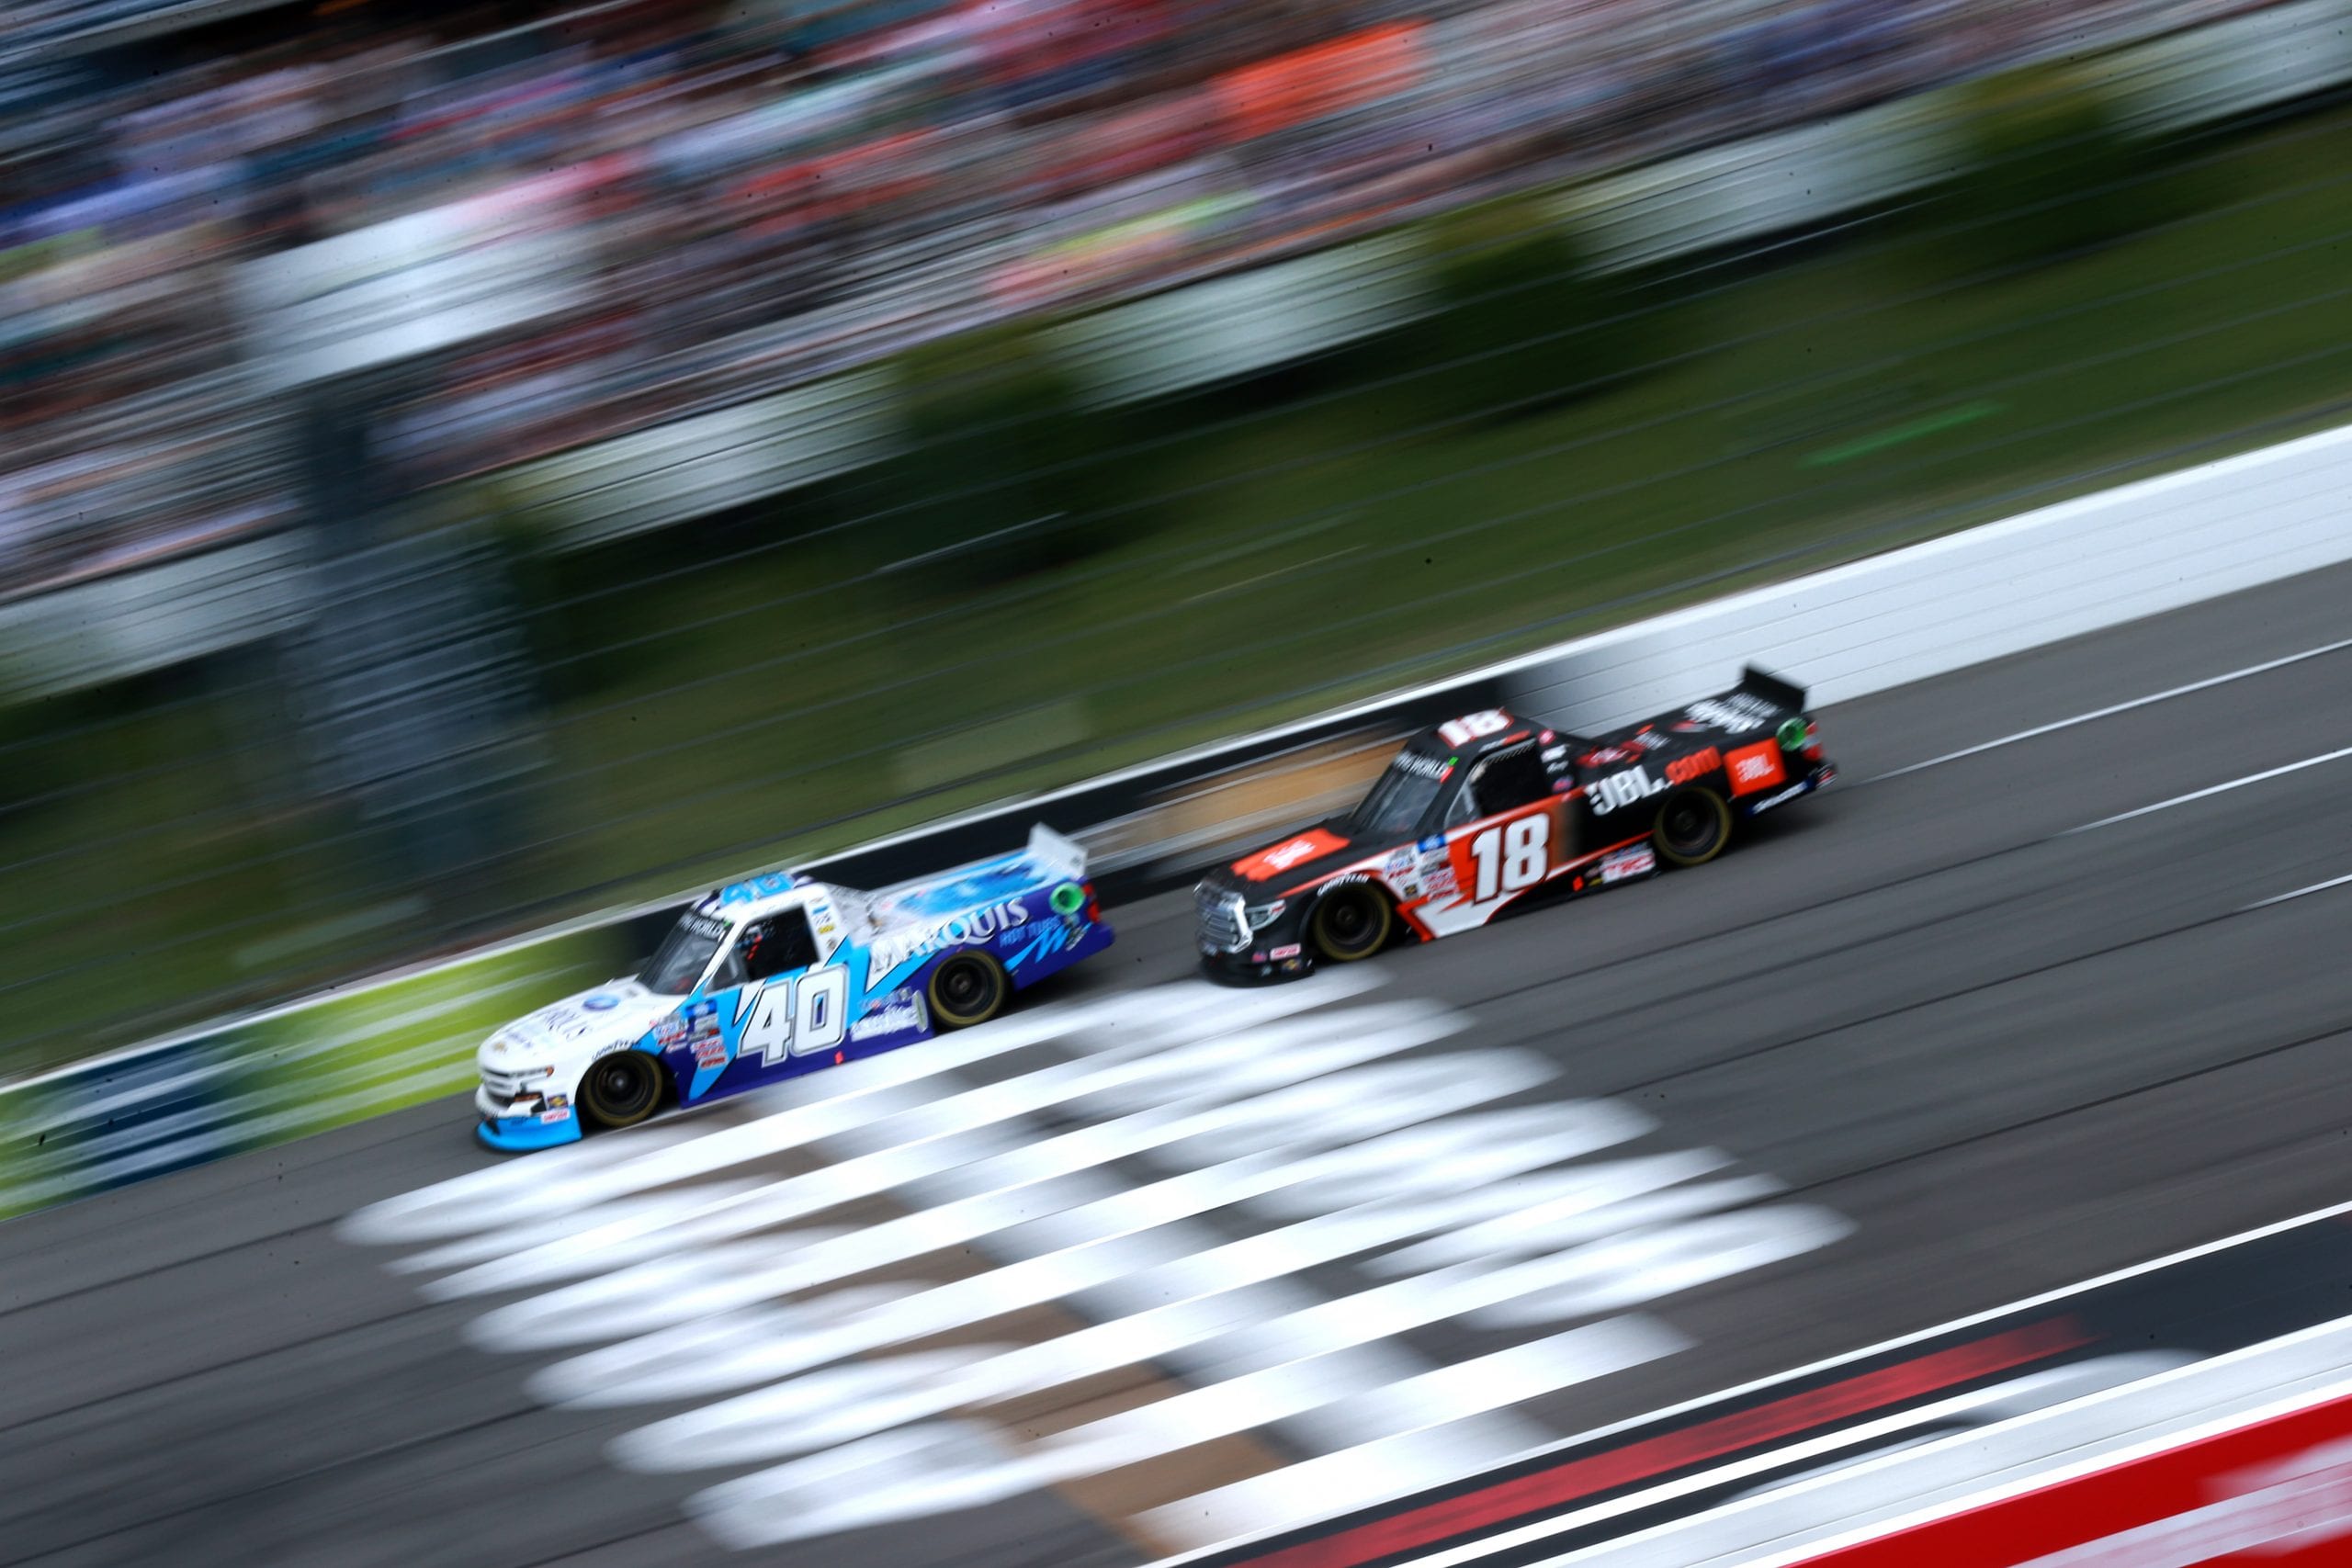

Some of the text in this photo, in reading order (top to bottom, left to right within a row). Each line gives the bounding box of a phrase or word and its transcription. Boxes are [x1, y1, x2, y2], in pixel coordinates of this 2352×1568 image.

[1437, 707, 1513, 749] 18
[1472, 812, 1550, 904] 18
[869, 896, 1029, 974] MARQUIS
[735, 963, 851, 1068] 40
